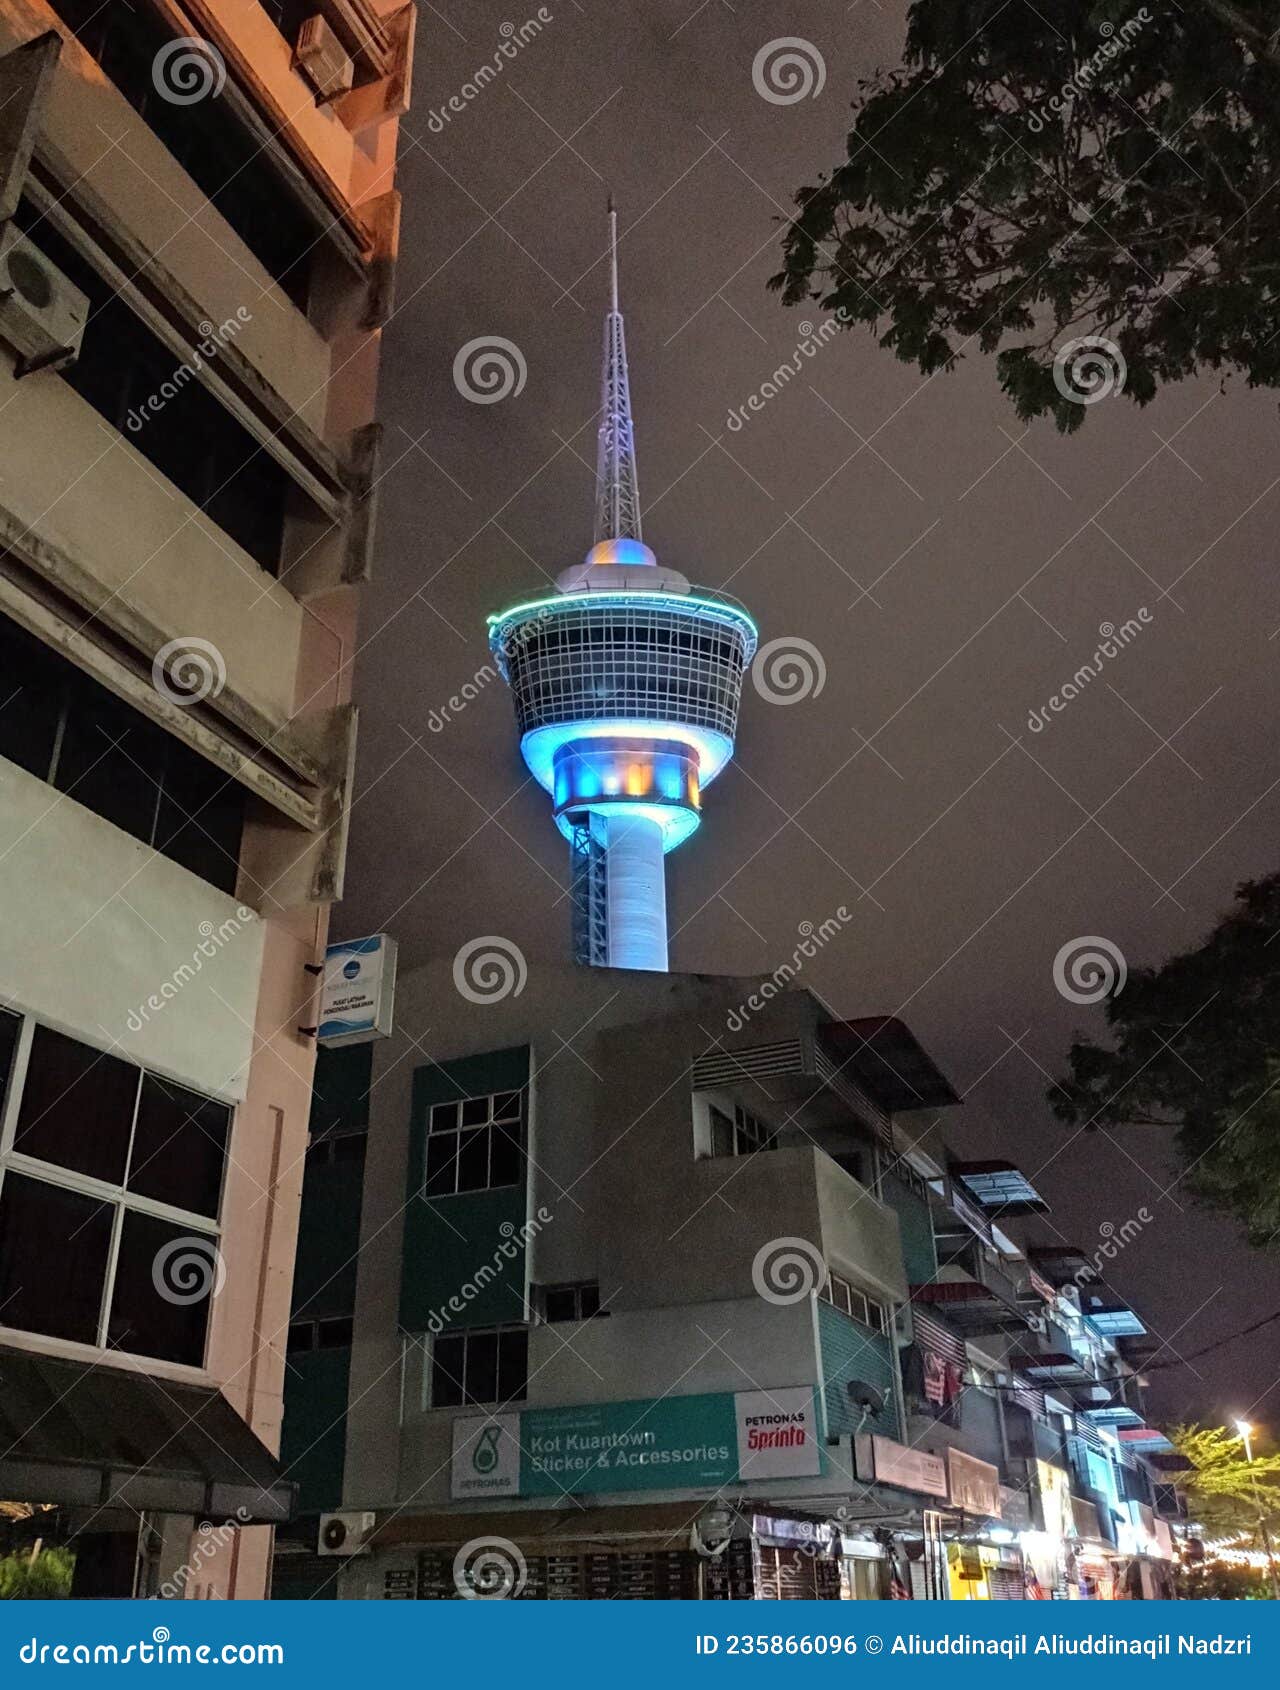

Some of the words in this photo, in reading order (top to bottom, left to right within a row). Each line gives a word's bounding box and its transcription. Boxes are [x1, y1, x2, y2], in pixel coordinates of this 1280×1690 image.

[745, 1413, 805, 1427] PETRONAS
[530, 1435, 561, 1453] Kot
[566, 1430, 656, 1450] Kuantown
[748, 1426, 806, 1451] Sprinto
[530, 1454, 593, 1473] Sticker
[597, 1451, 611, 1468] &
[615, 1444, 730, 1467] Accessories
[459, 1477, 512, 1490] PETRONAS
